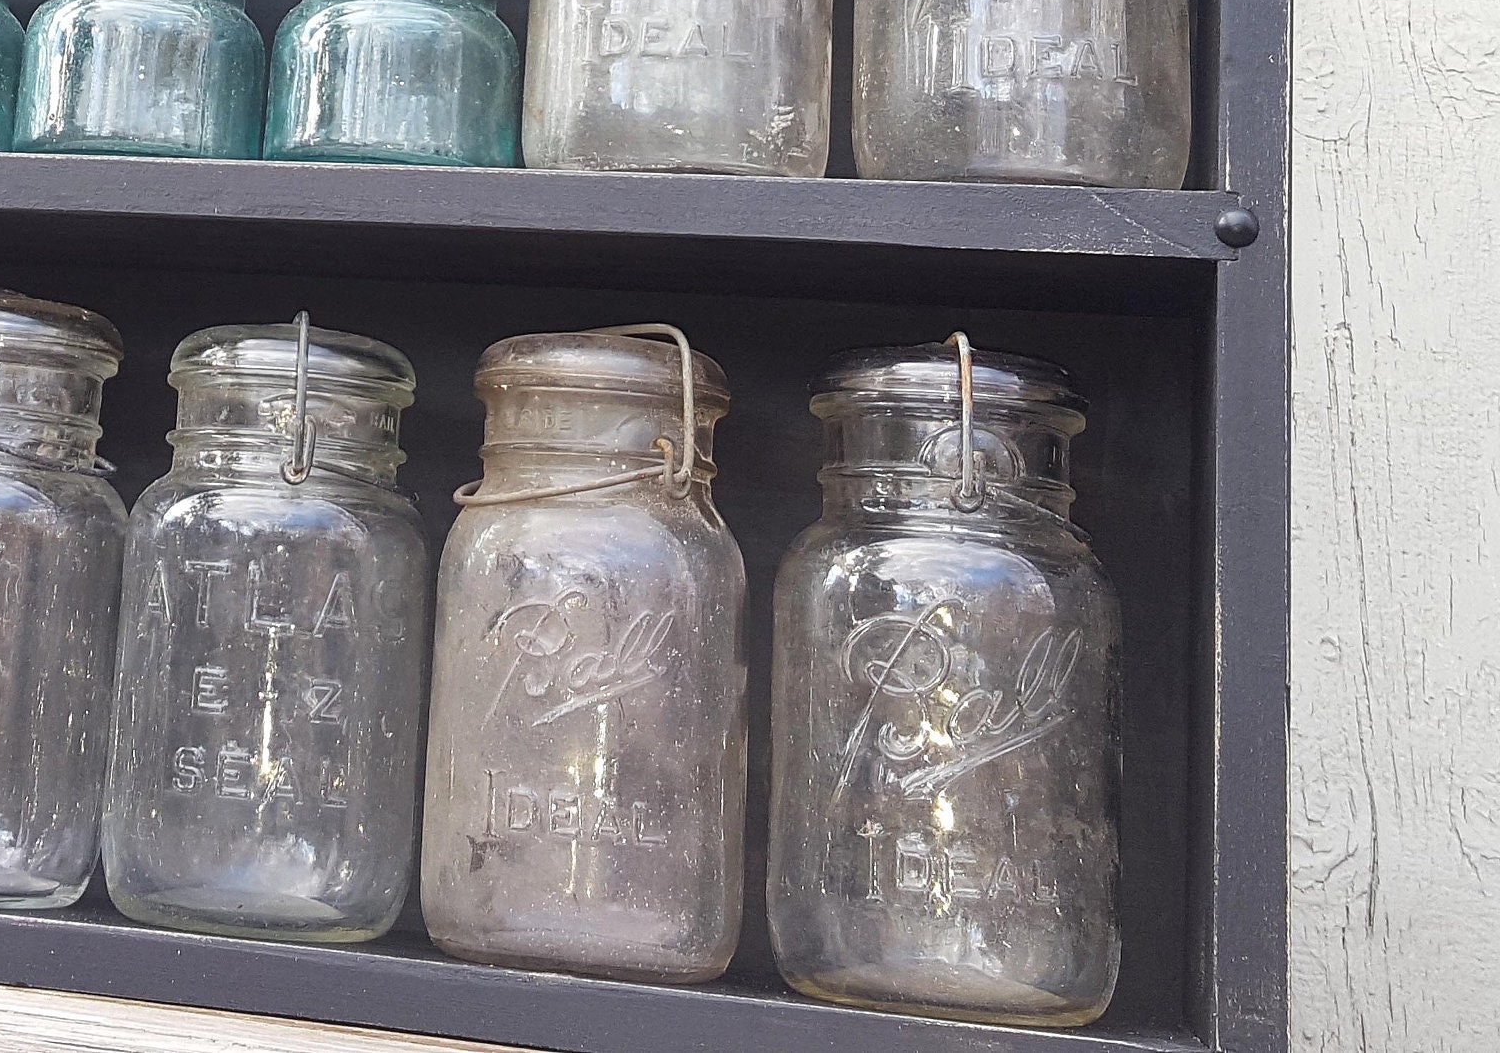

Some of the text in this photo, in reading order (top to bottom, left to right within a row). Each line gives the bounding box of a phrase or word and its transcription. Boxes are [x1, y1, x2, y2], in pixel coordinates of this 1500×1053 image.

[576, 2, 752, 65] IDEAL
[946, 15, 1140, 95] IDEAL
[479, 590, 676, 729] Ball
[830, 597, 1085, 807] Ball
[171, 744, 350, 811] SEAL
[482, 769, 664, 845] IDEAL
